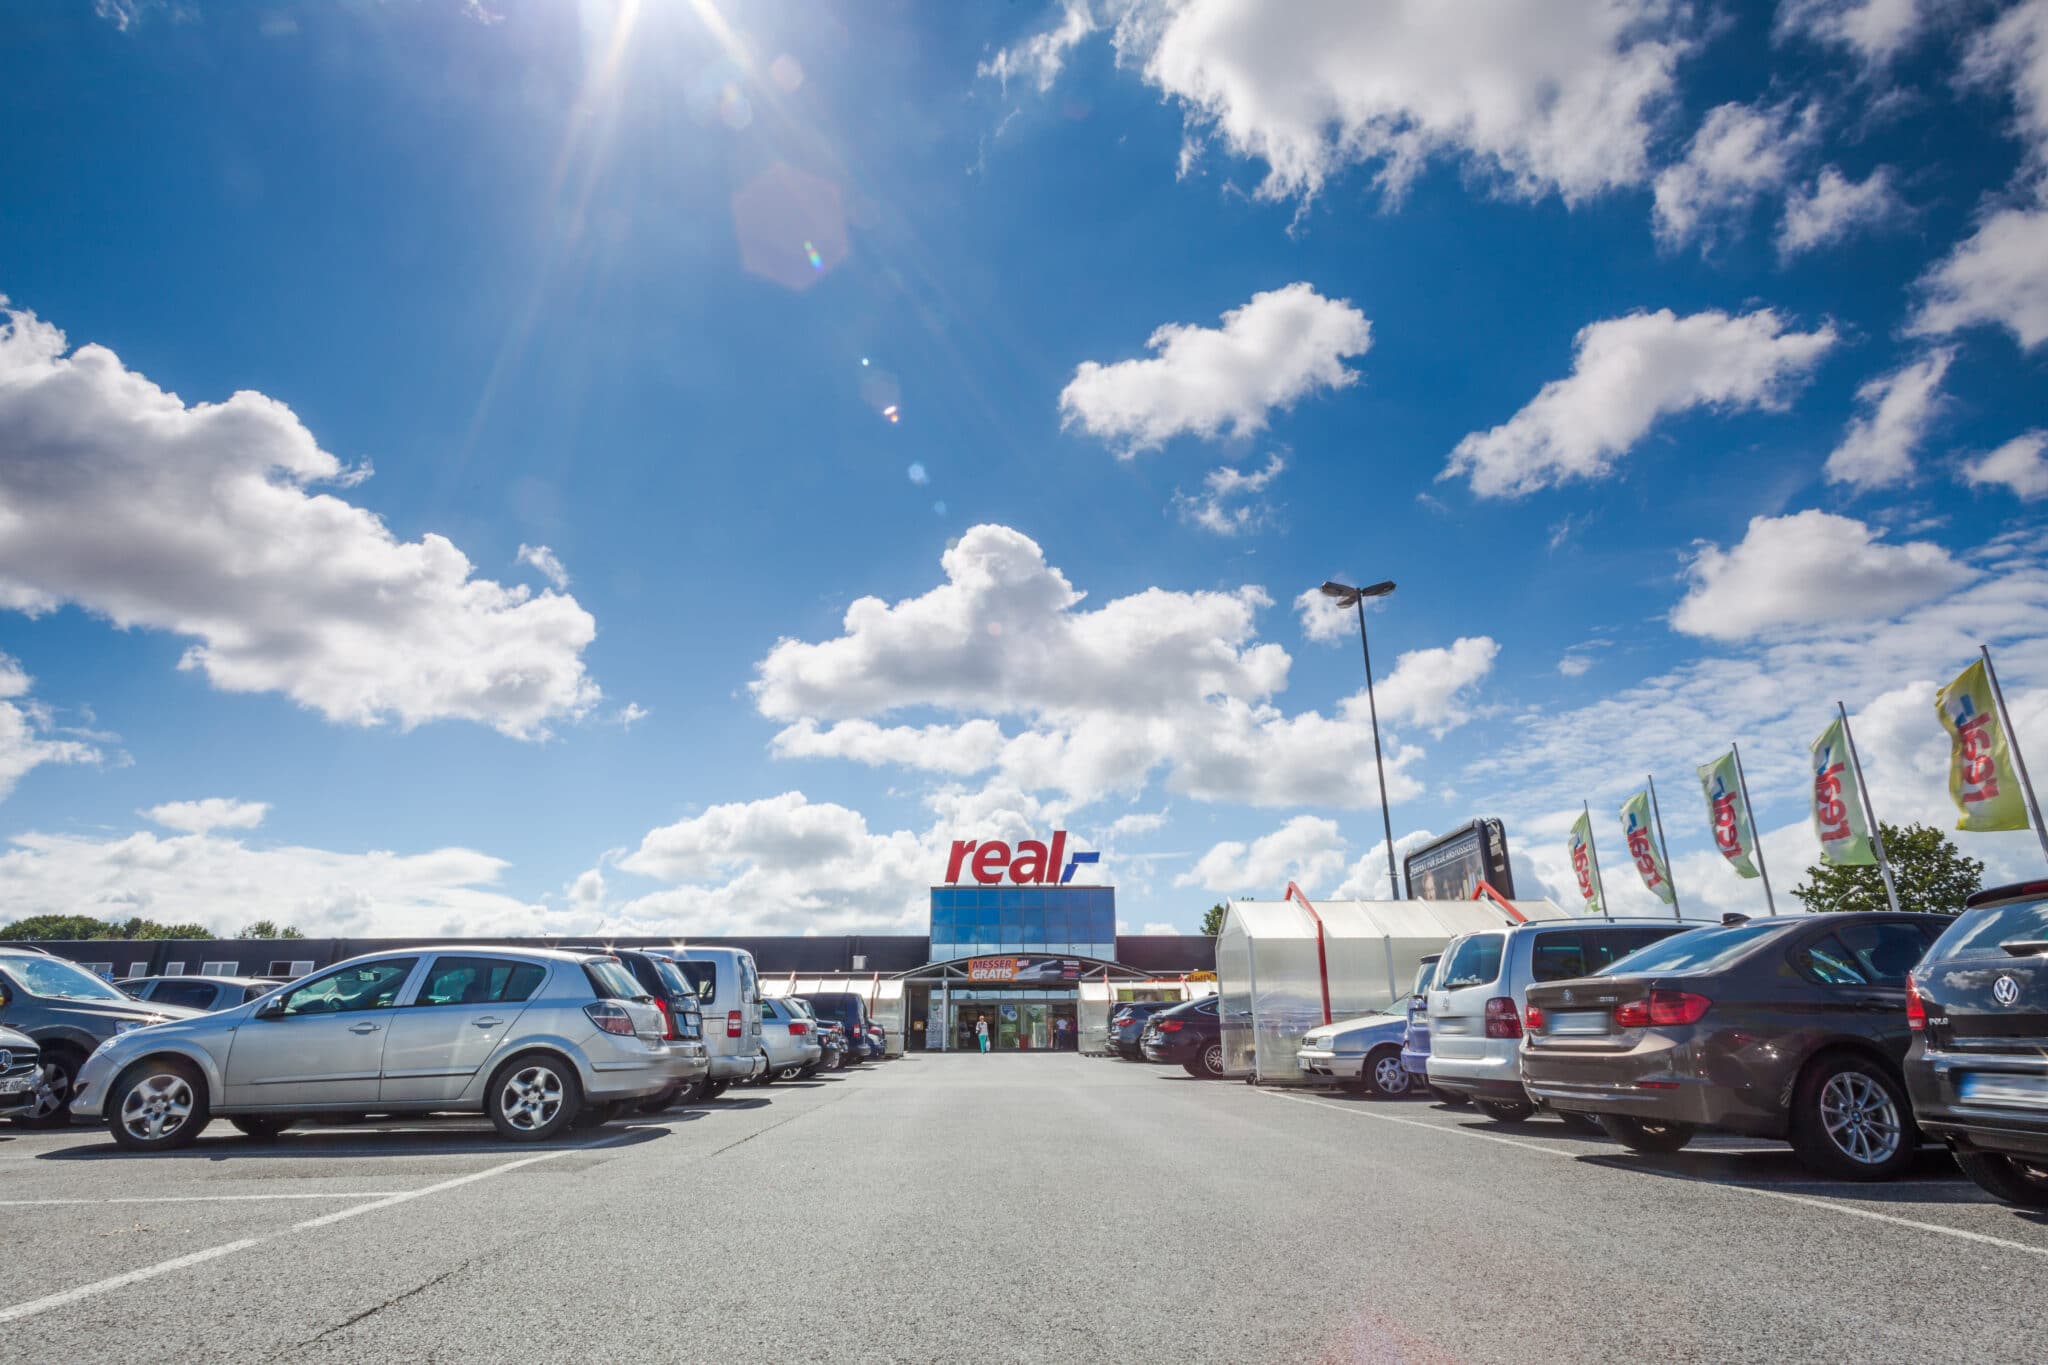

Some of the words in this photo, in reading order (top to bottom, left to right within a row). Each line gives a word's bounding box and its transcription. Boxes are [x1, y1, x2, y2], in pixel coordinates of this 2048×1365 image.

[972, 960, 1012, 969] MESSER
[971, 968, 1012, 980] GRATIS
[1928, 1017, 1949, 1026] POLO
